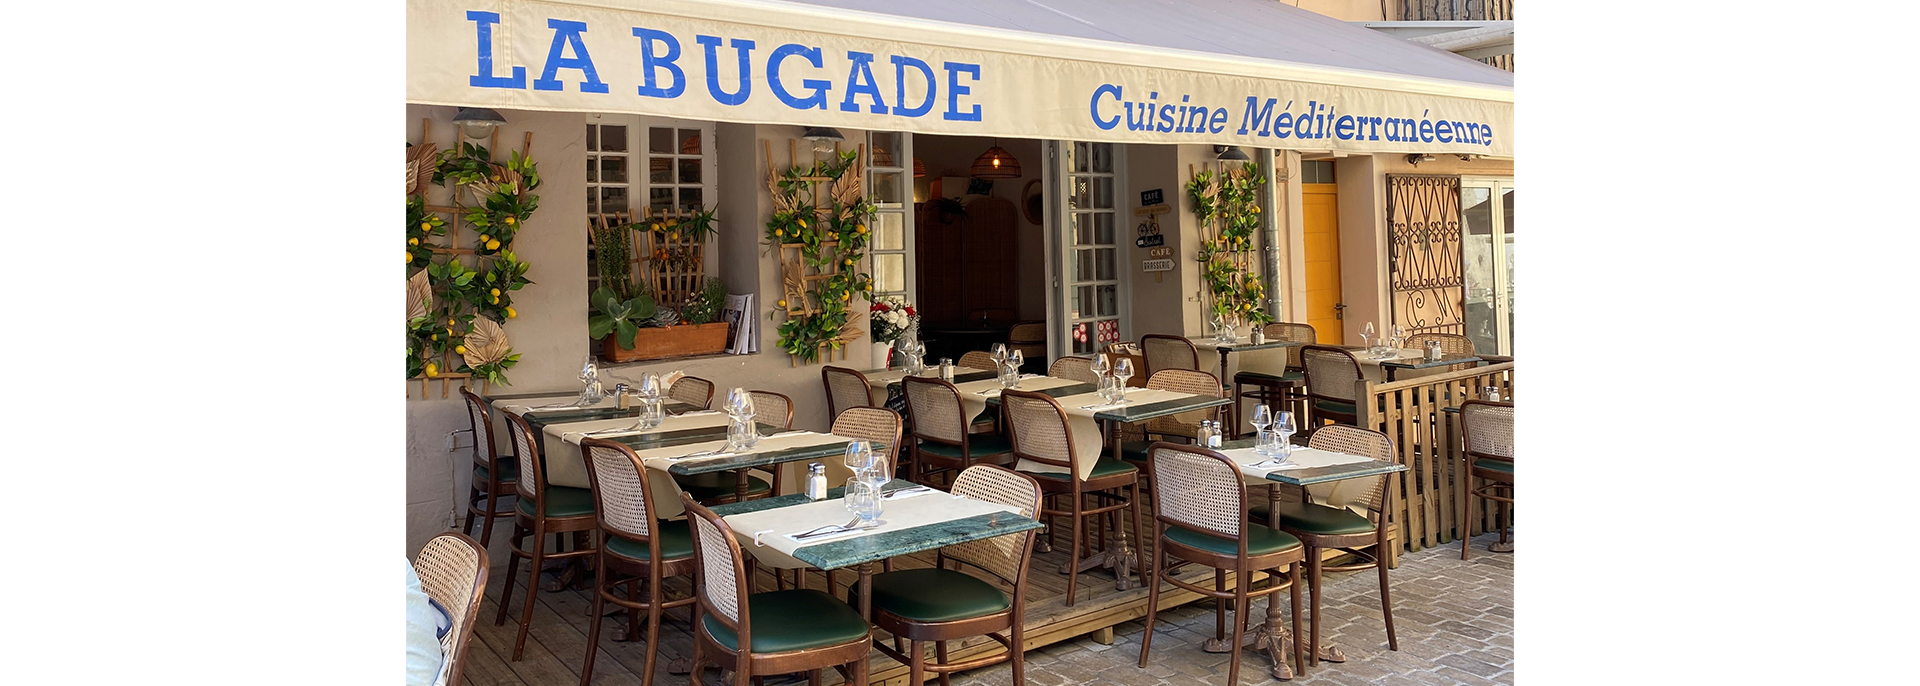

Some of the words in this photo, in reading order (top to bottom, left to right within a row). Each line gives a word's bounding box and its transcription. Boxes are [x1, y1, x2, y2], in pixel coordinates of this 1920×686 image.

[466, 10, 609, 94] LA
[632, 27, 982, 122] BUGADE
[1090, 83, 1228, 134] Cuisine
[1236, 96, 1492, 146] Méditerranéenne
[1144, 260, 1170, 270] BRASSERIE
